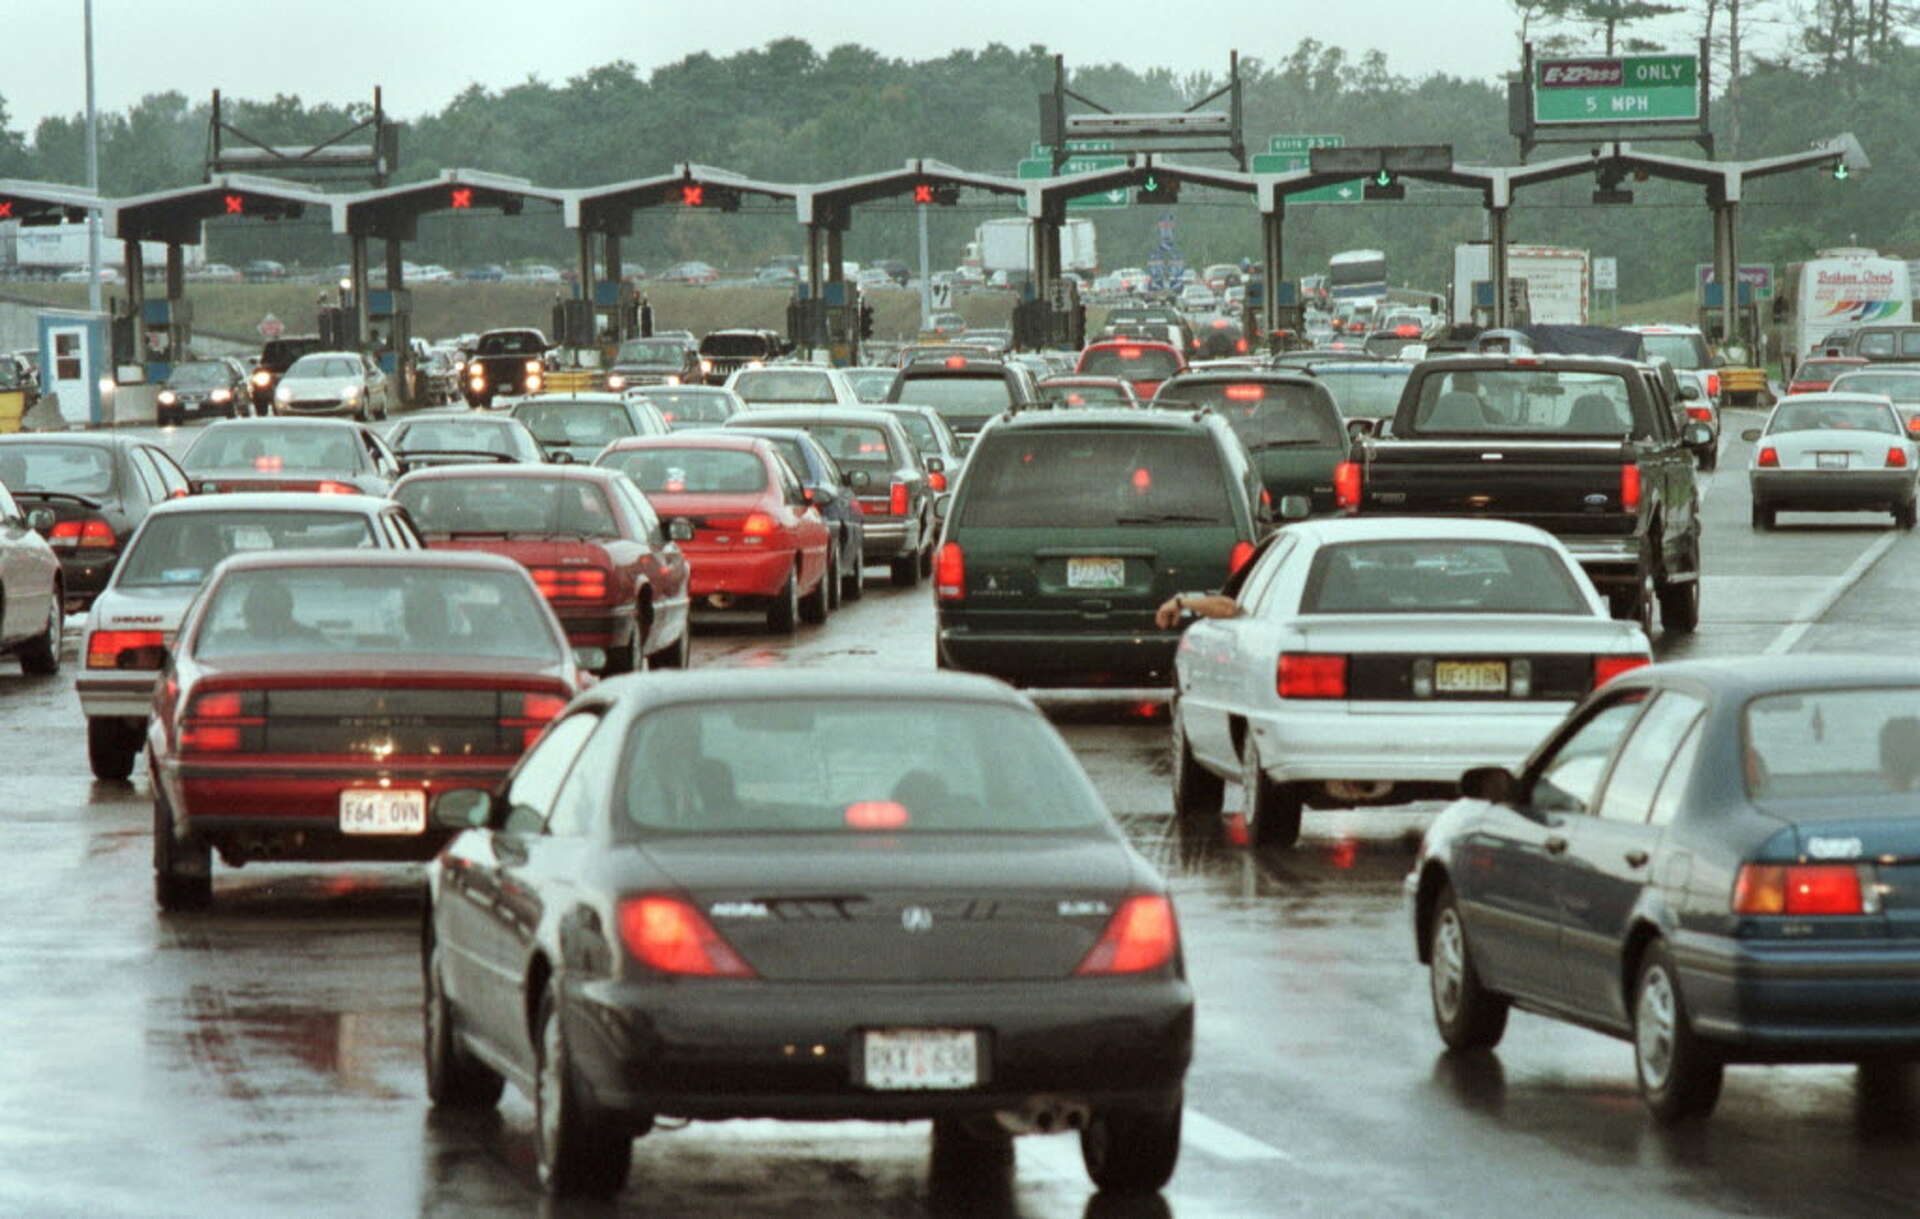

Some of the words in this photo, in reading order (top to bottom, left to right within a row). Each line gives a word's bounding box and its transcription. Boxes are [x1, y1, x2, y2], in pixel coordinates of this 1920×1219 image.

[1543, 65, 1621, 83] E-ZPass
[1636, 63, 1682, 80] ONLY
[1586, 96, 1597, 112] 5
[1612, 95, 1649, 111] MPH
